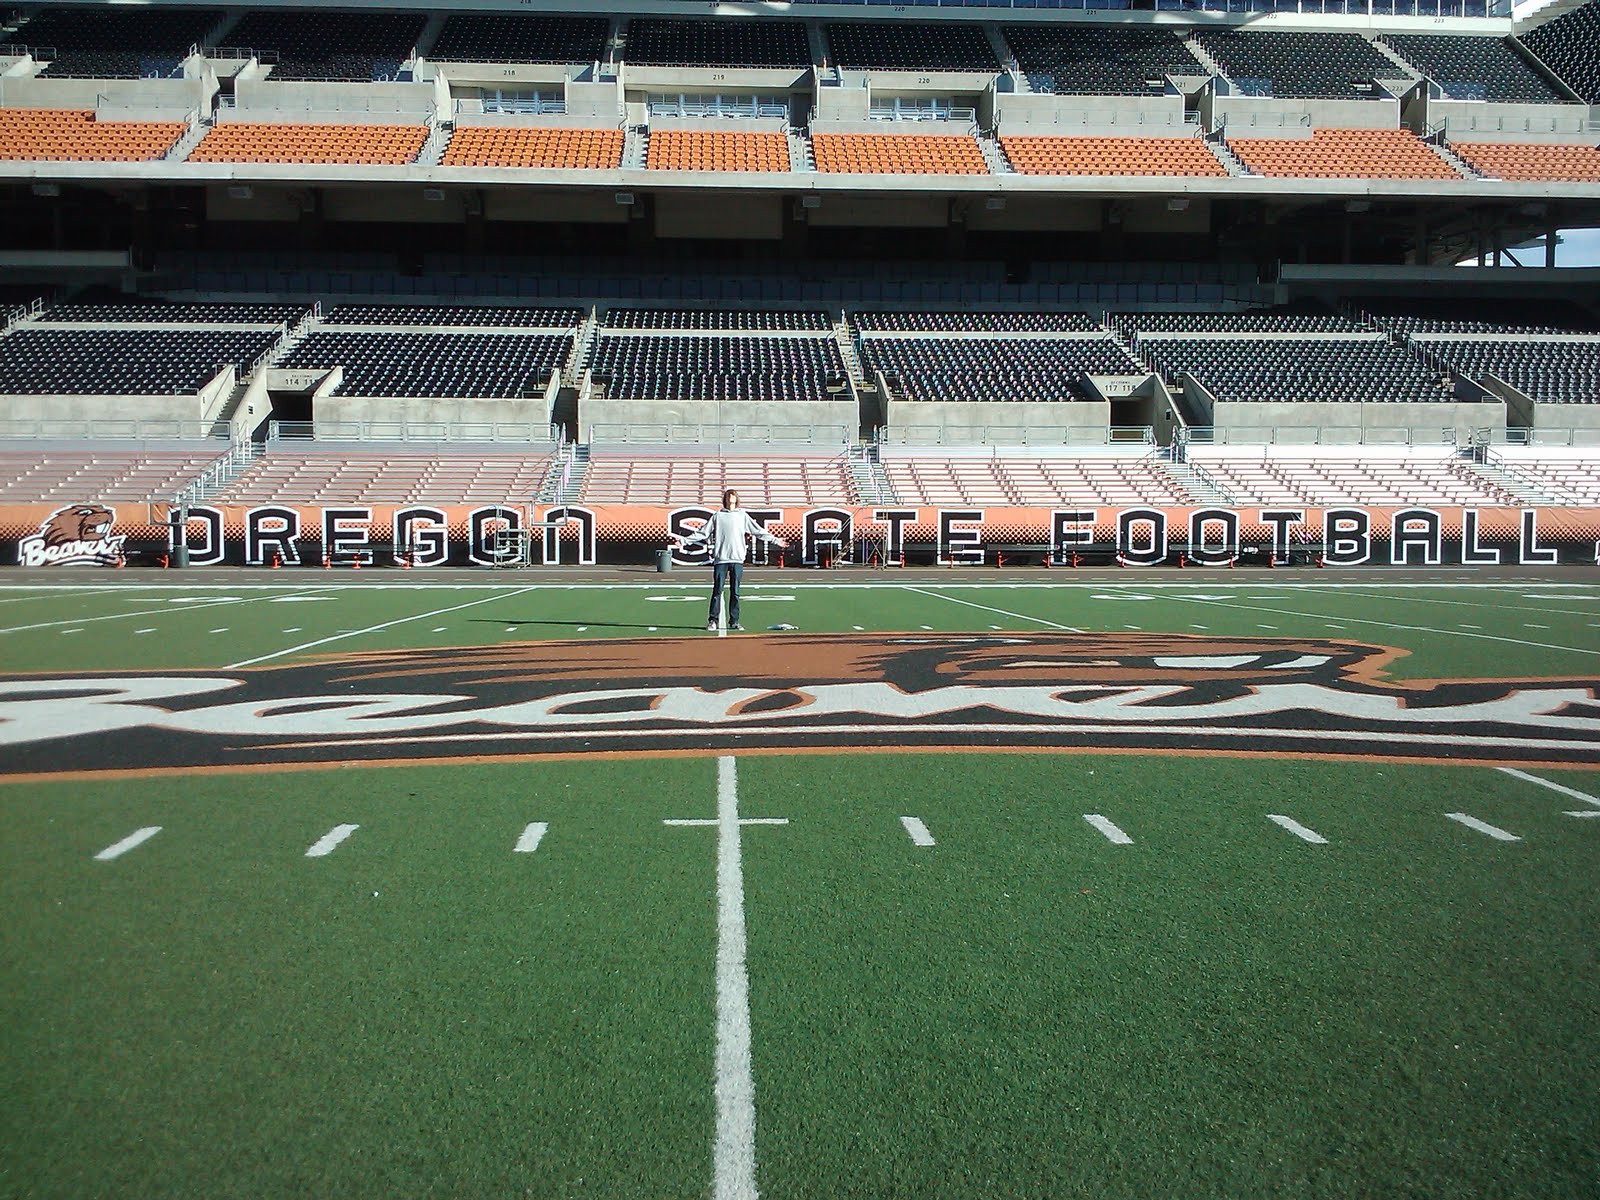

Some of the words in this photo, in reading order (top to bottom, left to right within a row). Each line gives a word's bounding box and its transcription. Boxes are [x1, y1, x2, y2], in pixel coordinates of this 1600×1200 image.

[168, 504, 597, 567] OREGON
[667, 506, 985, 566] STATE
[1050, 507, 1558, 566] FOOTBALL
